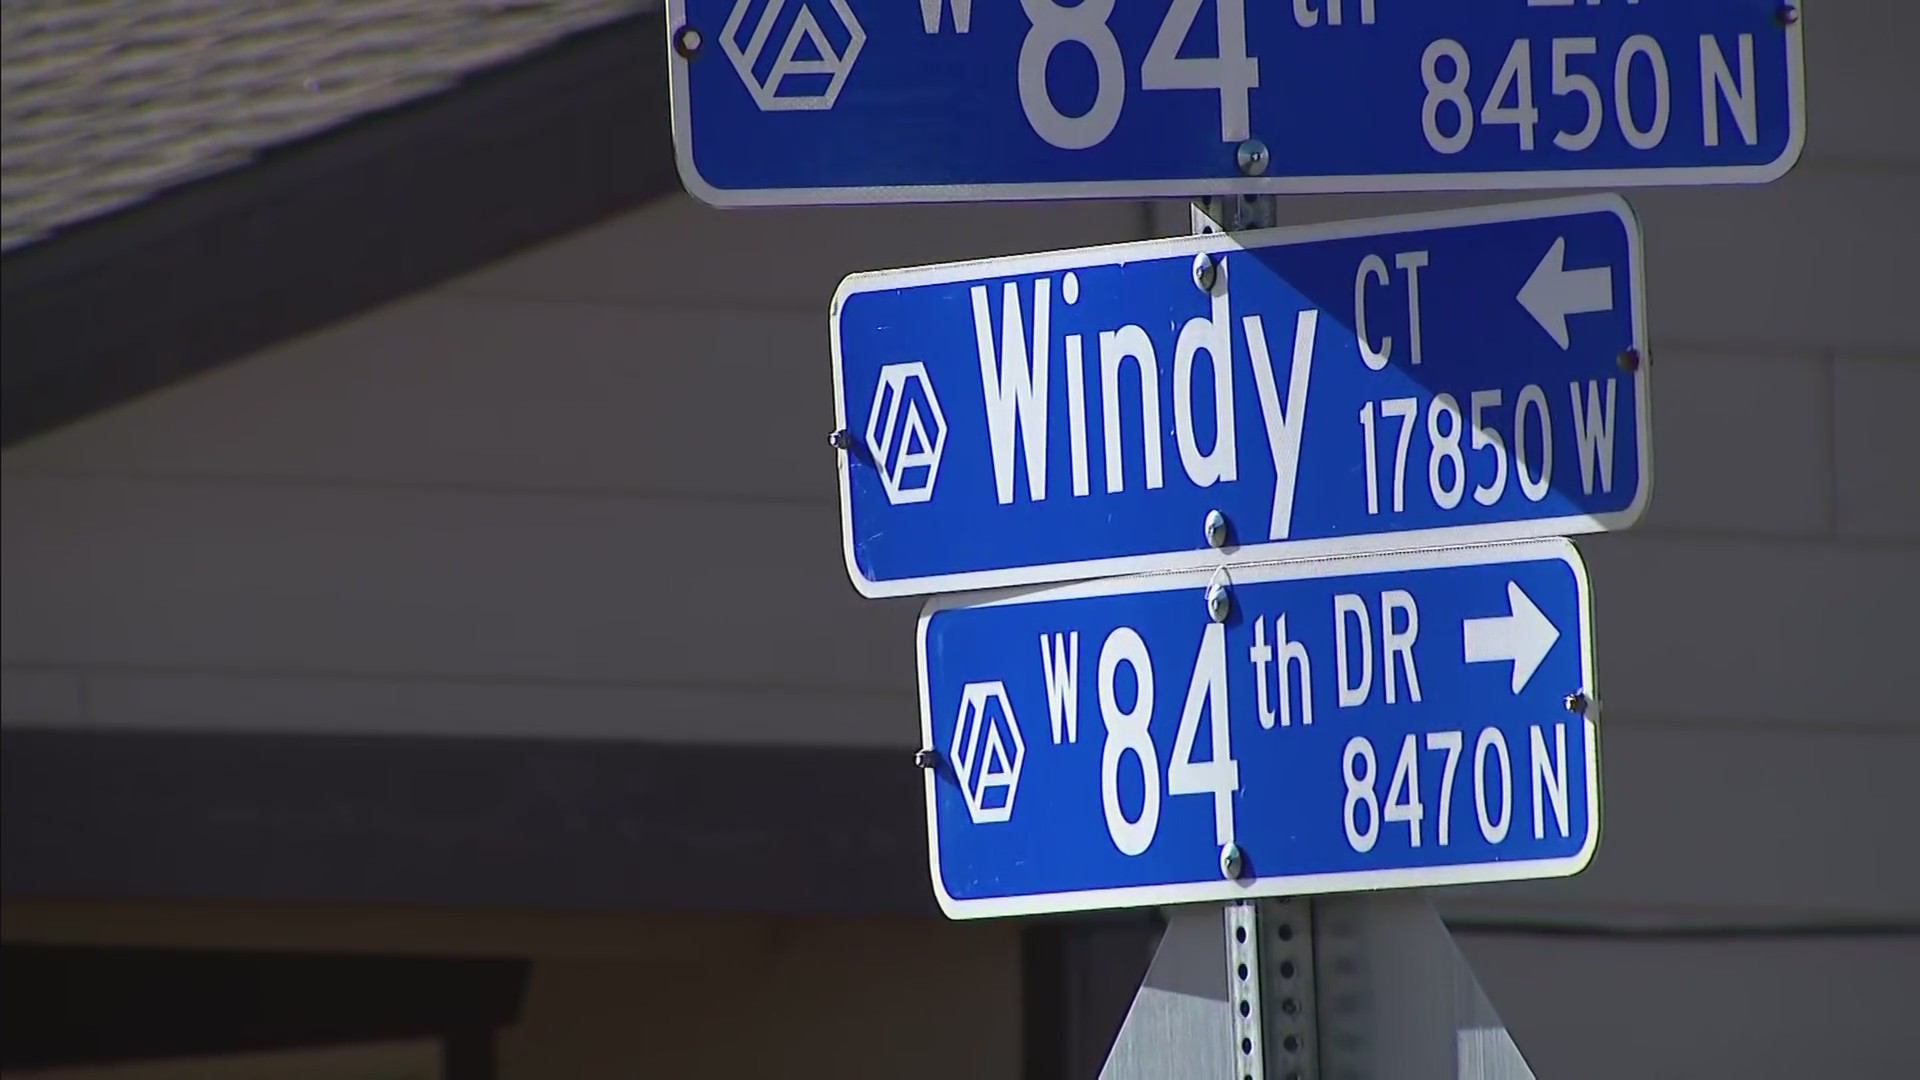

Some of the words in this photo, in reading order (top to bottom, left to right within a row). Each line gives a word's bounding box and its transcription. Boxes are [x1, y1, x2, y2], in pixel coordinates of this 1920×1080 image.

[1420, 34, 1670, 154] 8450
[1699, 33, 1758, 147] N
[970, 256, 1319, 541] Windy
[1354, 250, 1428, 370] CT
[1359, 383, 1553, 515] 17850
[1569, 378, 1618, 496] W
[1039, 631, 1078, 745] W
[1334, 589, 1422, 708] DR
[1342, 726, 1512, 853] 8470
[1531, 722, 1570, 840] N
